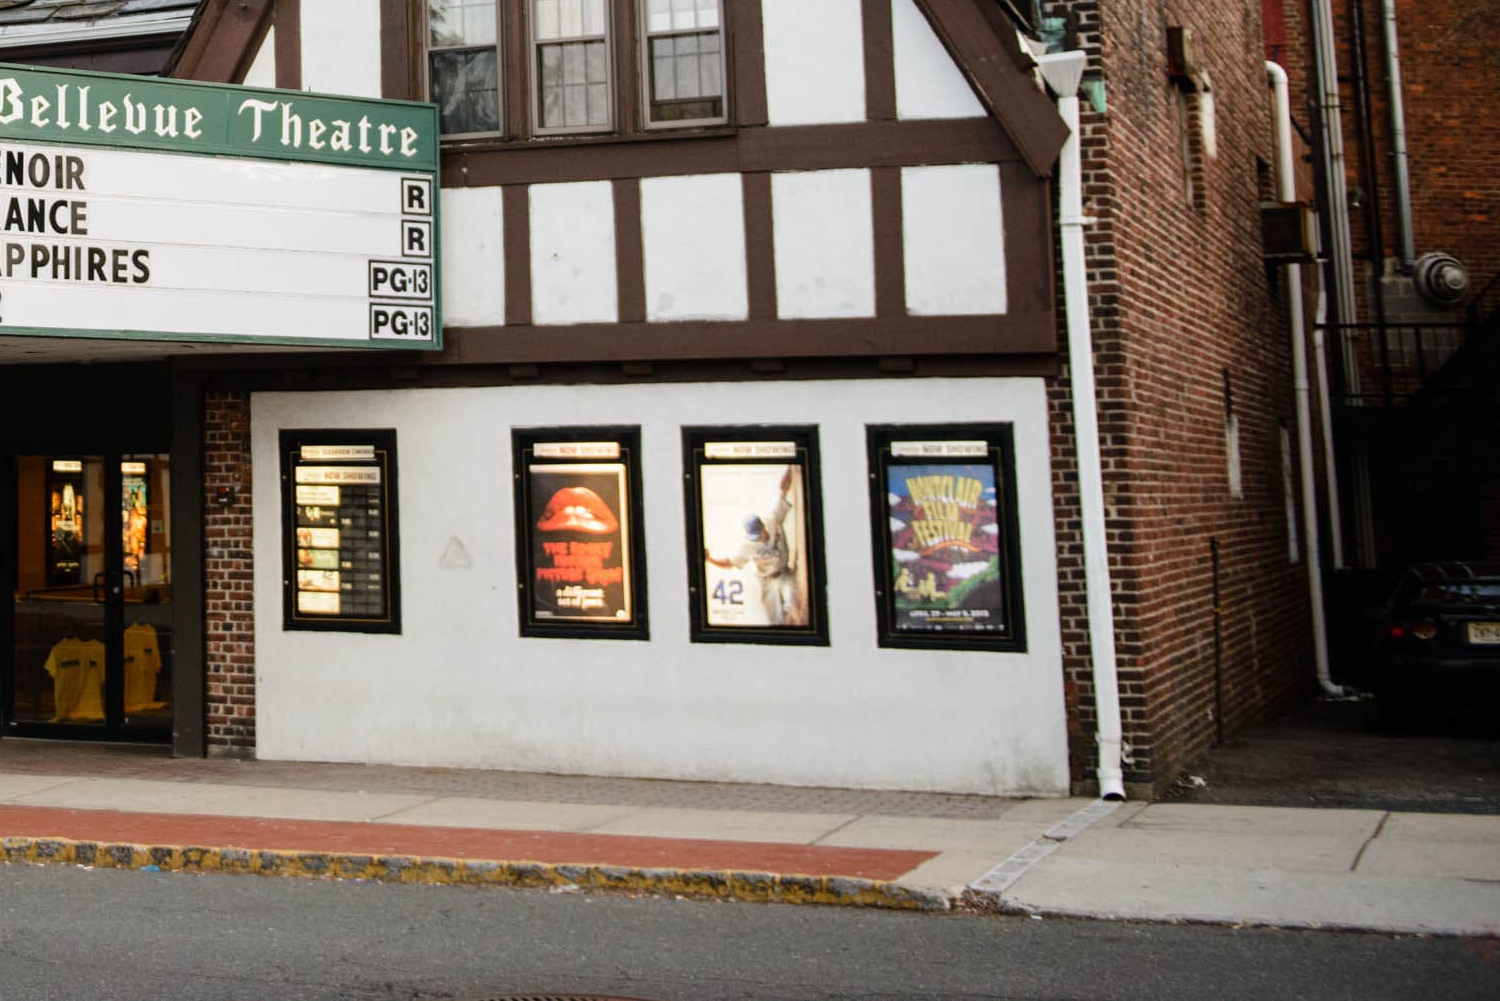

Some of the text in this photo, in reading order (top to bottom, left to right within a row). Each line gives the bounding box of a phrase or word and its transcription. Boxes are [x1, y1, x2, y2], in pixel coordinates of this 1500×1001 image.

[238, 98, 418, 157] Theatre
[407, 184, 425, 210] R
[407, 226, 425, 252] R
[324, 471, 376, 481] NOW SHOWING
[906, 475, 983, 510] MONTCLAIR
[912, 519, 973, 548] FESTIVAL
[711, 579, 744, 605] 42
